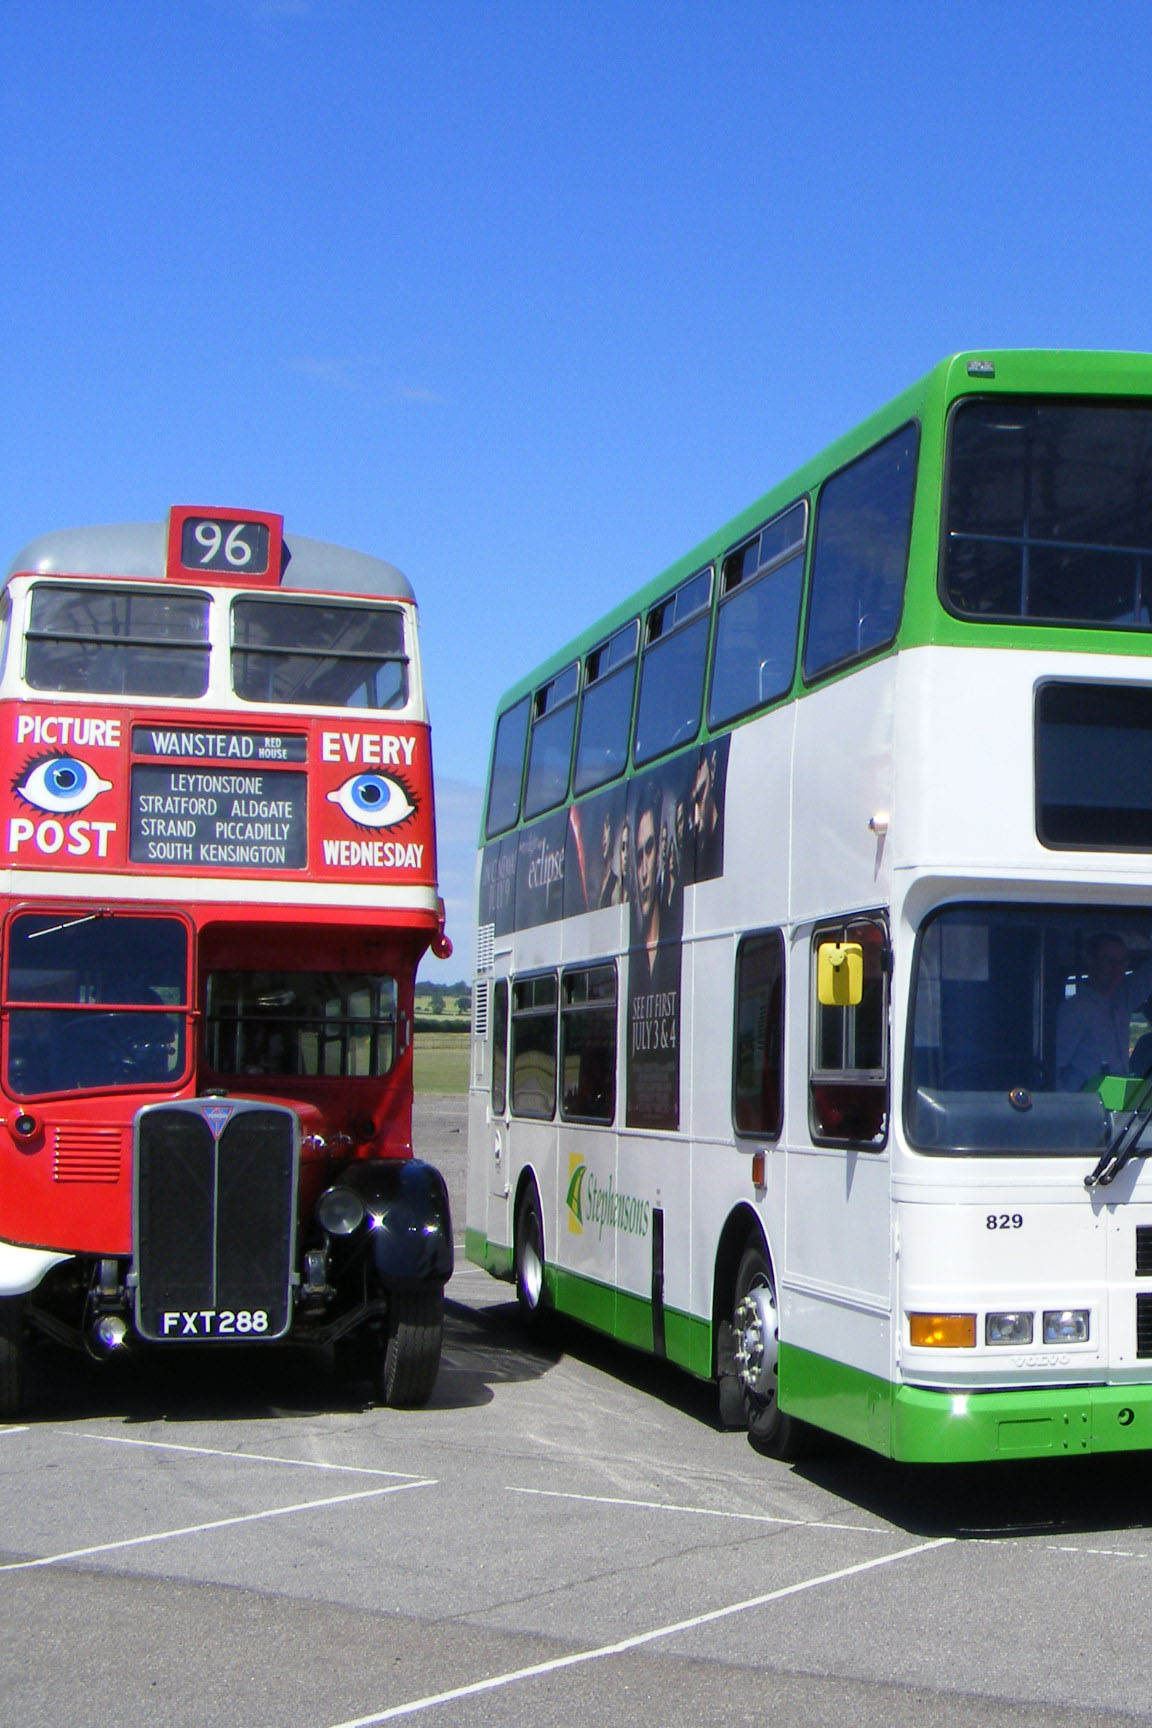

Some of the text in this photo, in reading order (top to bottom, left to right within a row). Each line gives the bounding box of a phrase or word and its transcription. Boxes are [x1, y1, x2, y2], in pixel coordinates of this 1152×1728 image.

[195, 521, 252, 566] 96
[16, 715, 121, 747] PICTURE
[151, 731, 254, 758] WANSTEAD
[264, 737, 282, 748] RED
[258, 748, 288, 760] HOUSE
[322, 731, 416, 766] EVERY
[171, 773, 263, 795] LEYTONSTONE
[139, 795, 293, 818] STRATFORD ALDGATE
[8, 818, 117, 857] POST
[140, 818, 290, 841] STRAND PICCADILLY
[148, 841, 285, 864] SOUTH KENSINGTON
[323, 839, 424, 869] WEDNESDAY
[528, 837, 565, 909] eclipse
[632, 992, 677, 1020] SEE IT FIRST
[632, 1019, 676, 1058] JULY 3 & 4
[585, 1172, 650, 1242] Stephensons
[986, 1213, 1023, 1230] 829
